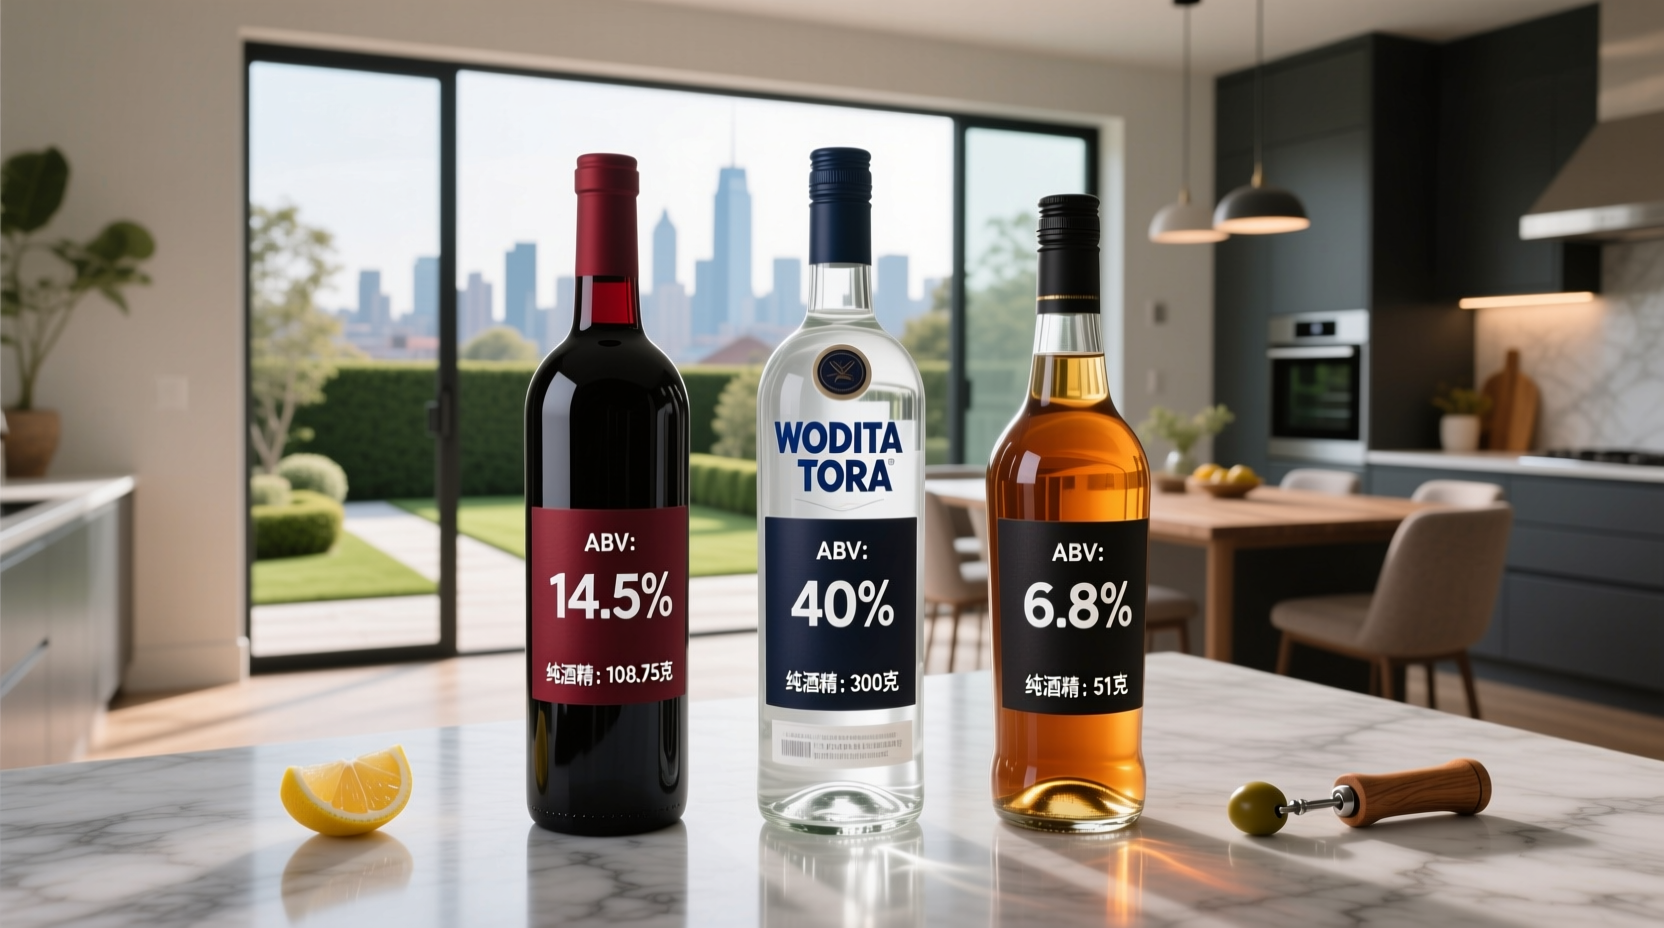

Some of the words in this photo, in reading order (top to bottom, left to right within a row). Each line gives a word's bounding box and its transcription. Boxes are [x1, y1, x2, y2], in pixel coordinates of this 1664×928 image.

[774, 421, 903, 454] WODITA
[797, 459, 893, 493] TORA
[584, 532, 636, 552] ABV:
[816, 541, 868, 560] ABV:
[1052, 542, 1104, 562] ABV:
[549, 570, 673, 620] 14.5%
[791, 579, 895, 628] 40%
[1023, 580, 1133, 629] 6.8%
